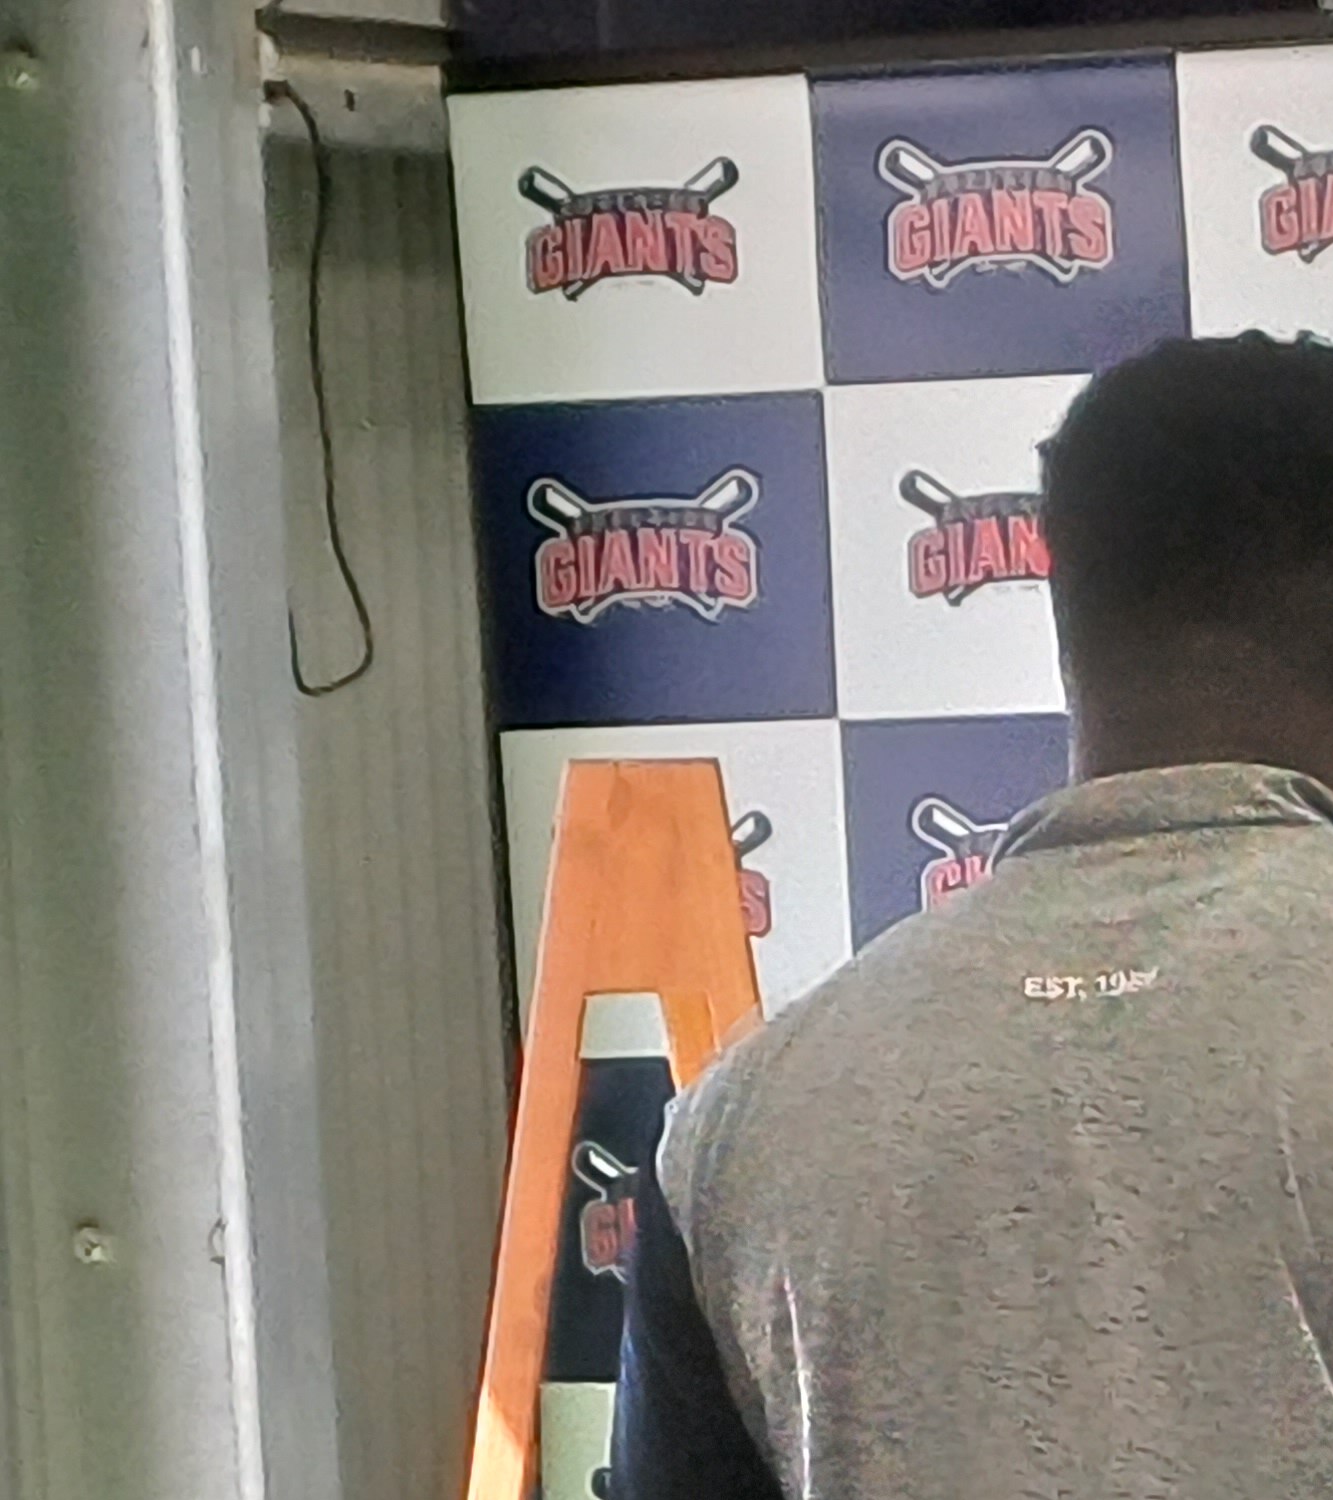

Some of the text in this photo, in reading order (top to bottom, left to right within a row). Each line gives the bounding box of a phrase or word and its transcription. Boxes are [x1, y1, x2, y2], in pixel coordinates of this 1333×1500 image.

[526, 209, 738, 293] GIANTS
[893, 188, 1108, 272] GIANTS
[540, 526, 750, 608] GIANTS
[908, 515, 1052, 598] GIAN
